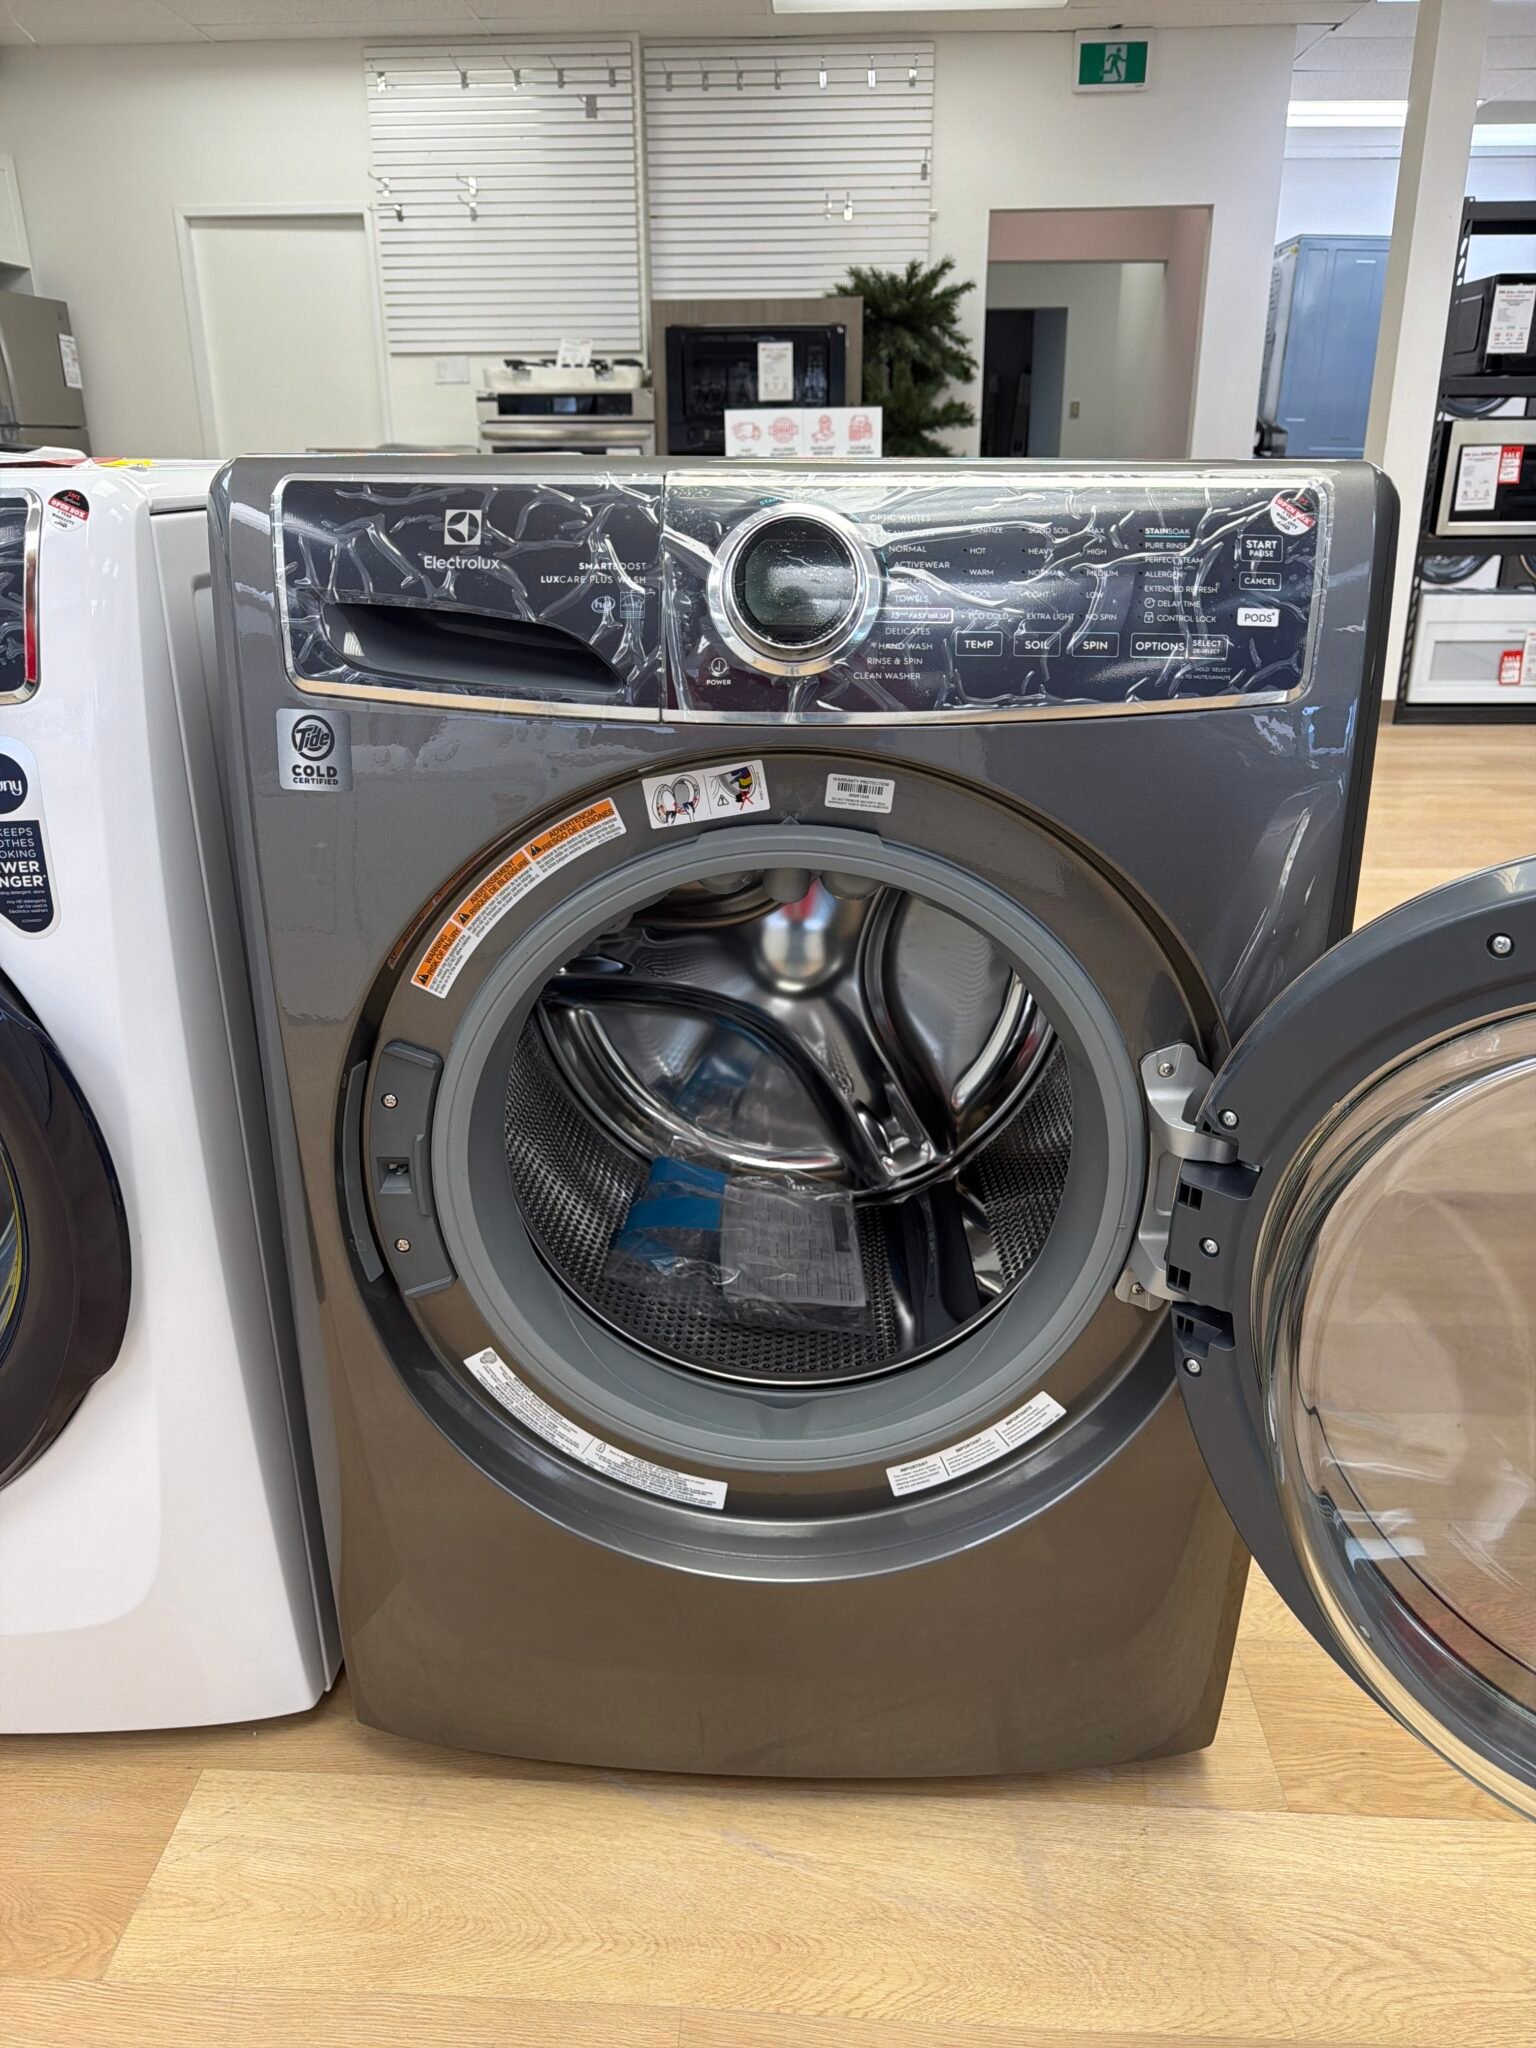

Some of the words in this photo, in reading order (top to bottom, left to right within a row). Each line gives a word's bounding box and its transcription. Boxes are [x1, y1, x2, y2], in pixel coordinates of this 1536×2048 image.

[51, 499, 70, 511] OPEN
[70, 507, 85, 519] BOX
[1246, 540, 1278, 549] START
[424, 556, 500, 570] Electrolux
[579, 562, 647, 570] SMARTBOOST
[541, 576, 586, 584] LUXCARE
[589, 576, 613, 584] PLUS
[617, 576, 646, 584] WASH
[1244, 577, 1276, 585] CANCEL
[896, 594, 929, 602] TOWELS
[964, 640, 994, 649] TEMP
[1024, 641, 1049, 649] SOIL
[1082, 641, 1108, 650] SPIN
[1135, 641, 1185, 651] OPTIONS
[867, 657, 892, 665] RINSE
[894, 657, 901, 665] &
[903, 657, 923, 665] SPIN
[295, 724, 330, 752] Tide
[292, 764, 338, 778] COLD
[292, 777, 339, 785] CERTIFIED
[548, 808, 596, 838] ADVERTENCIA
[541, 833, 567, 851] RIESGO
[568, 825, 578, 835] DE
[580, 808, 614, 826] LESIONES
[0, 860, 40, 874] WER
[469, 893, 490, 915] RISQUE
[489, 885, 499, 895] DE
[497, 858, 529, 888] BLESSURE
[470, 860, 515, 904] AVERTISSEMENT
[426, 933, 448, 964] WARNING
[427, 959, 440, 975] RISK
[435, 949, 446, 960] OF
[443, 927, 461, 951] INJURY
[955, 1437, 982, 1452] IMPORTANT
[900, 1461, 928, 1472] IMPORTANT
